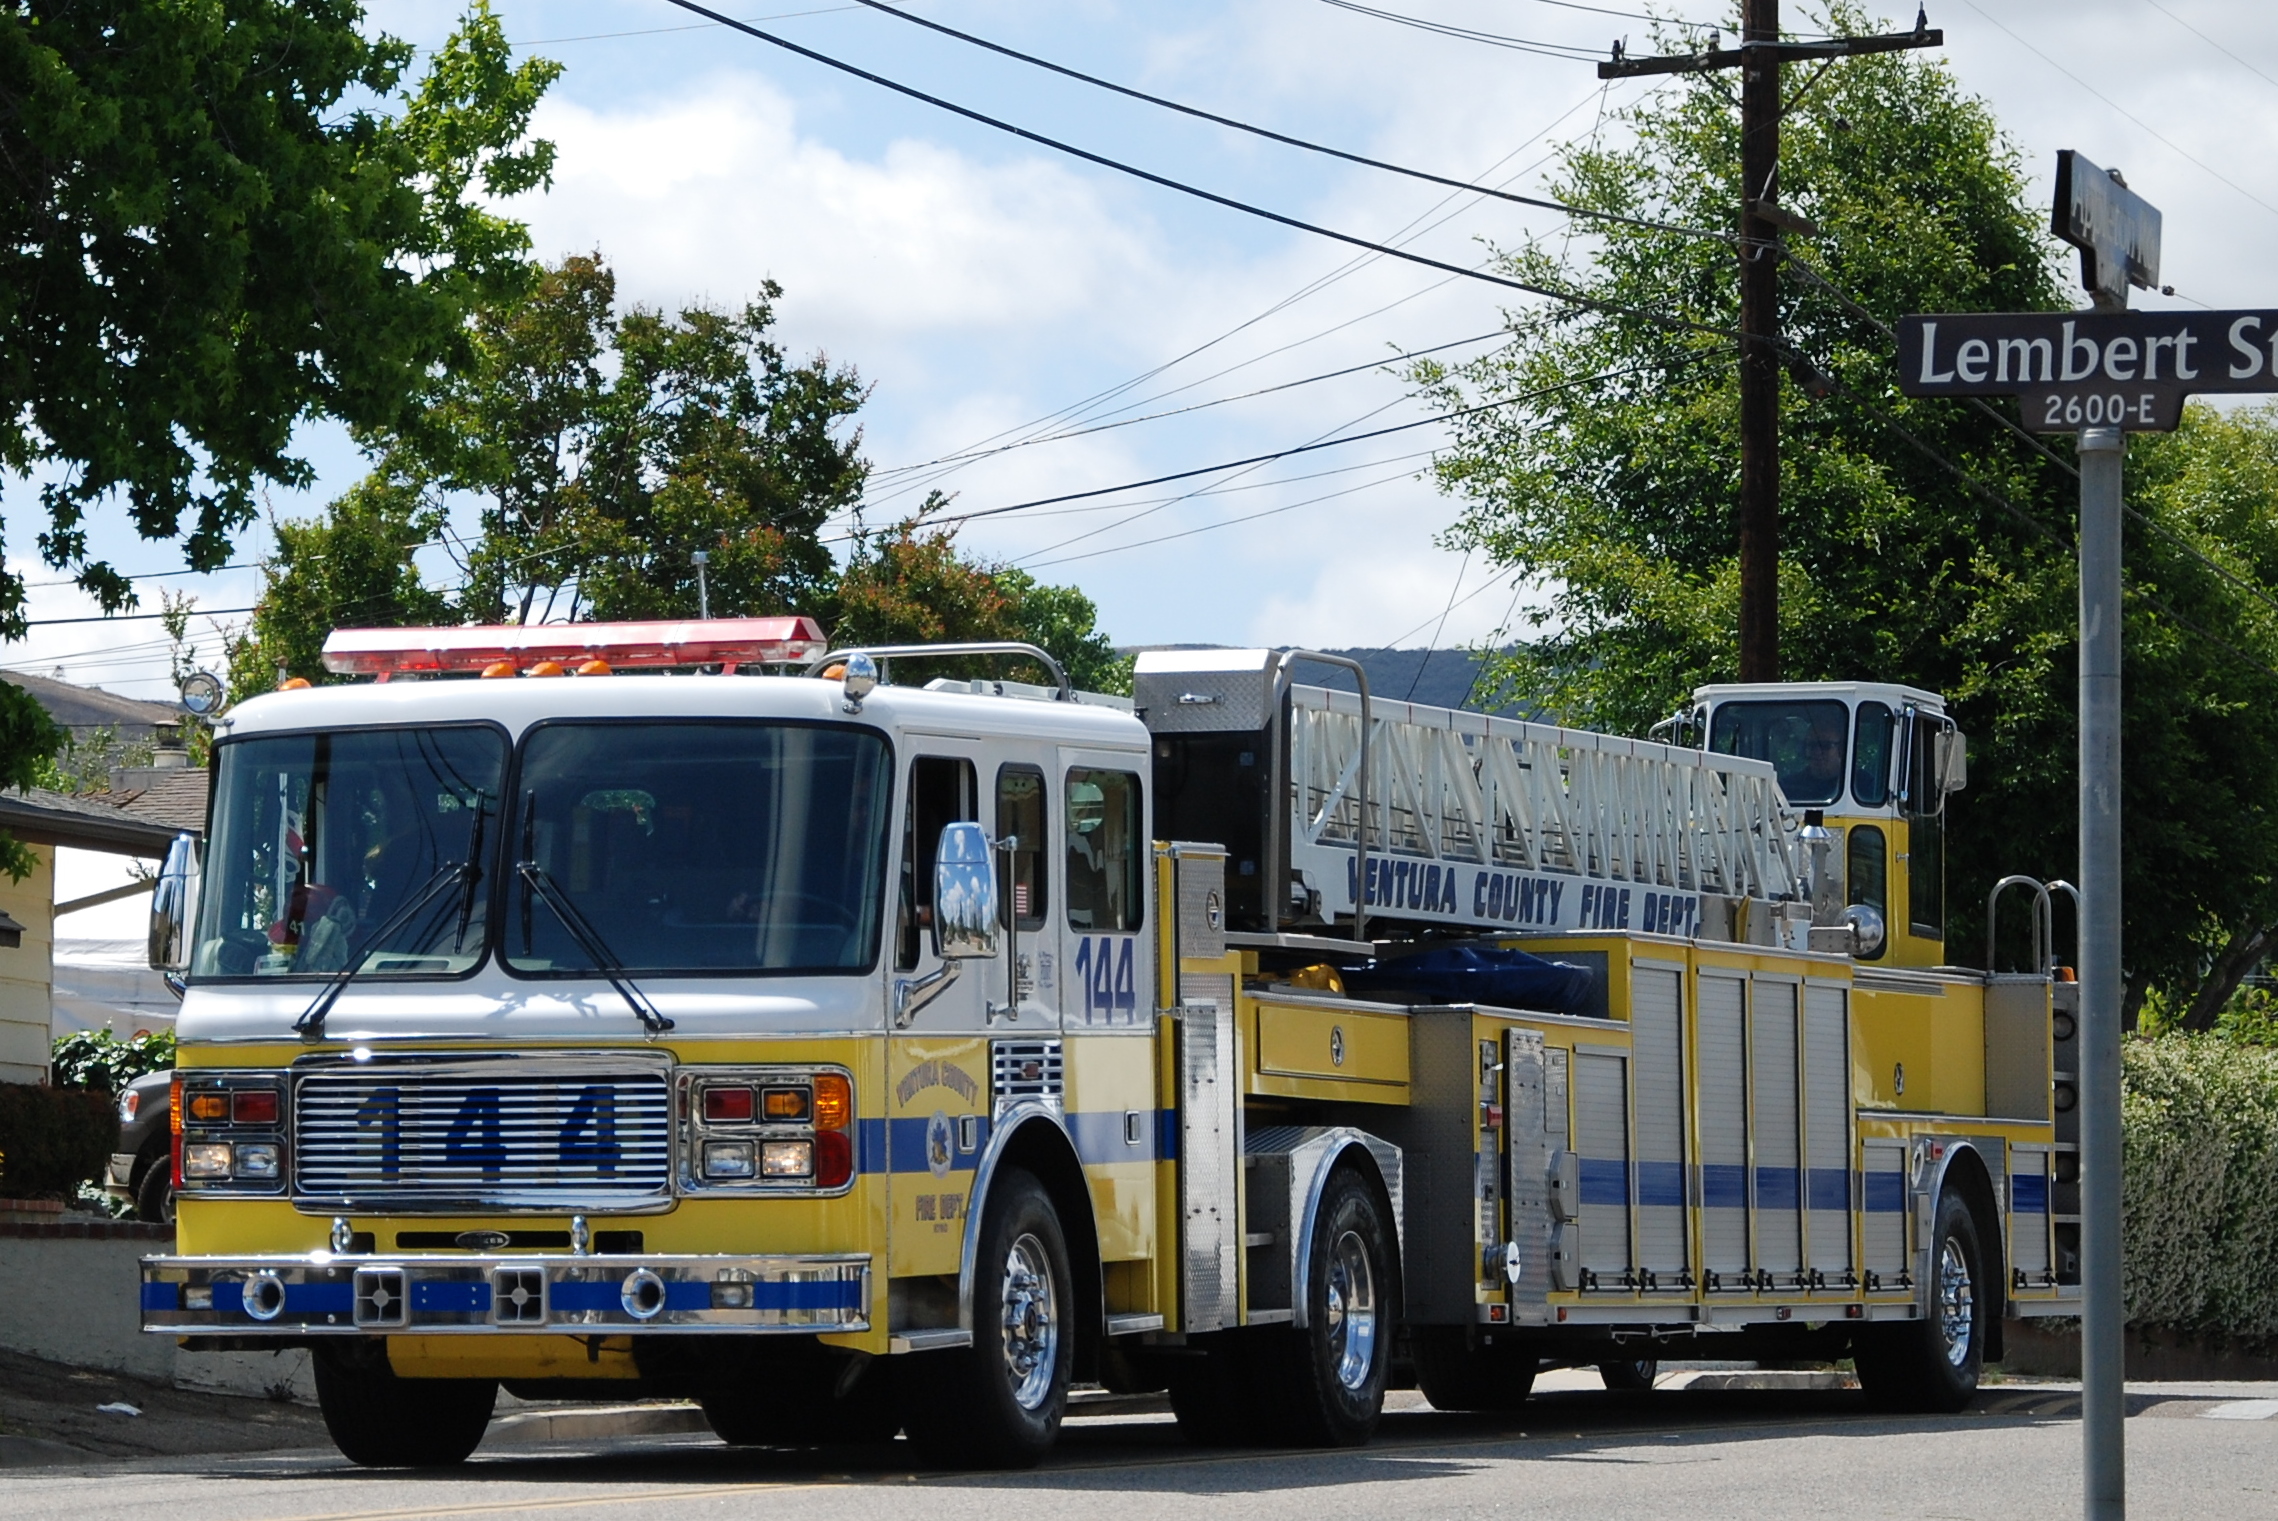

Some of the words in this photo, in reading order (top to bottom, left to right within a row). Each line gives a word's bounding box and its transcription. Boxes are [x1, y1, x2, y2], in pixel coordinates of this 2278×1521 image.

[1919, 320, 2198, 383] Lembert
[2044, 394, 2155, 425] 2600-E
[1347, 856, 1457, 914] VENTURA
[1473, 871, 1564, 925] COUNTY
[1579, 884, 1630, 929] FIRE
[1074, 936, 1135, 1025] 144
[358, 1085, 621, 1182] 144
[915, 1194, 936, 1221] FIRE
